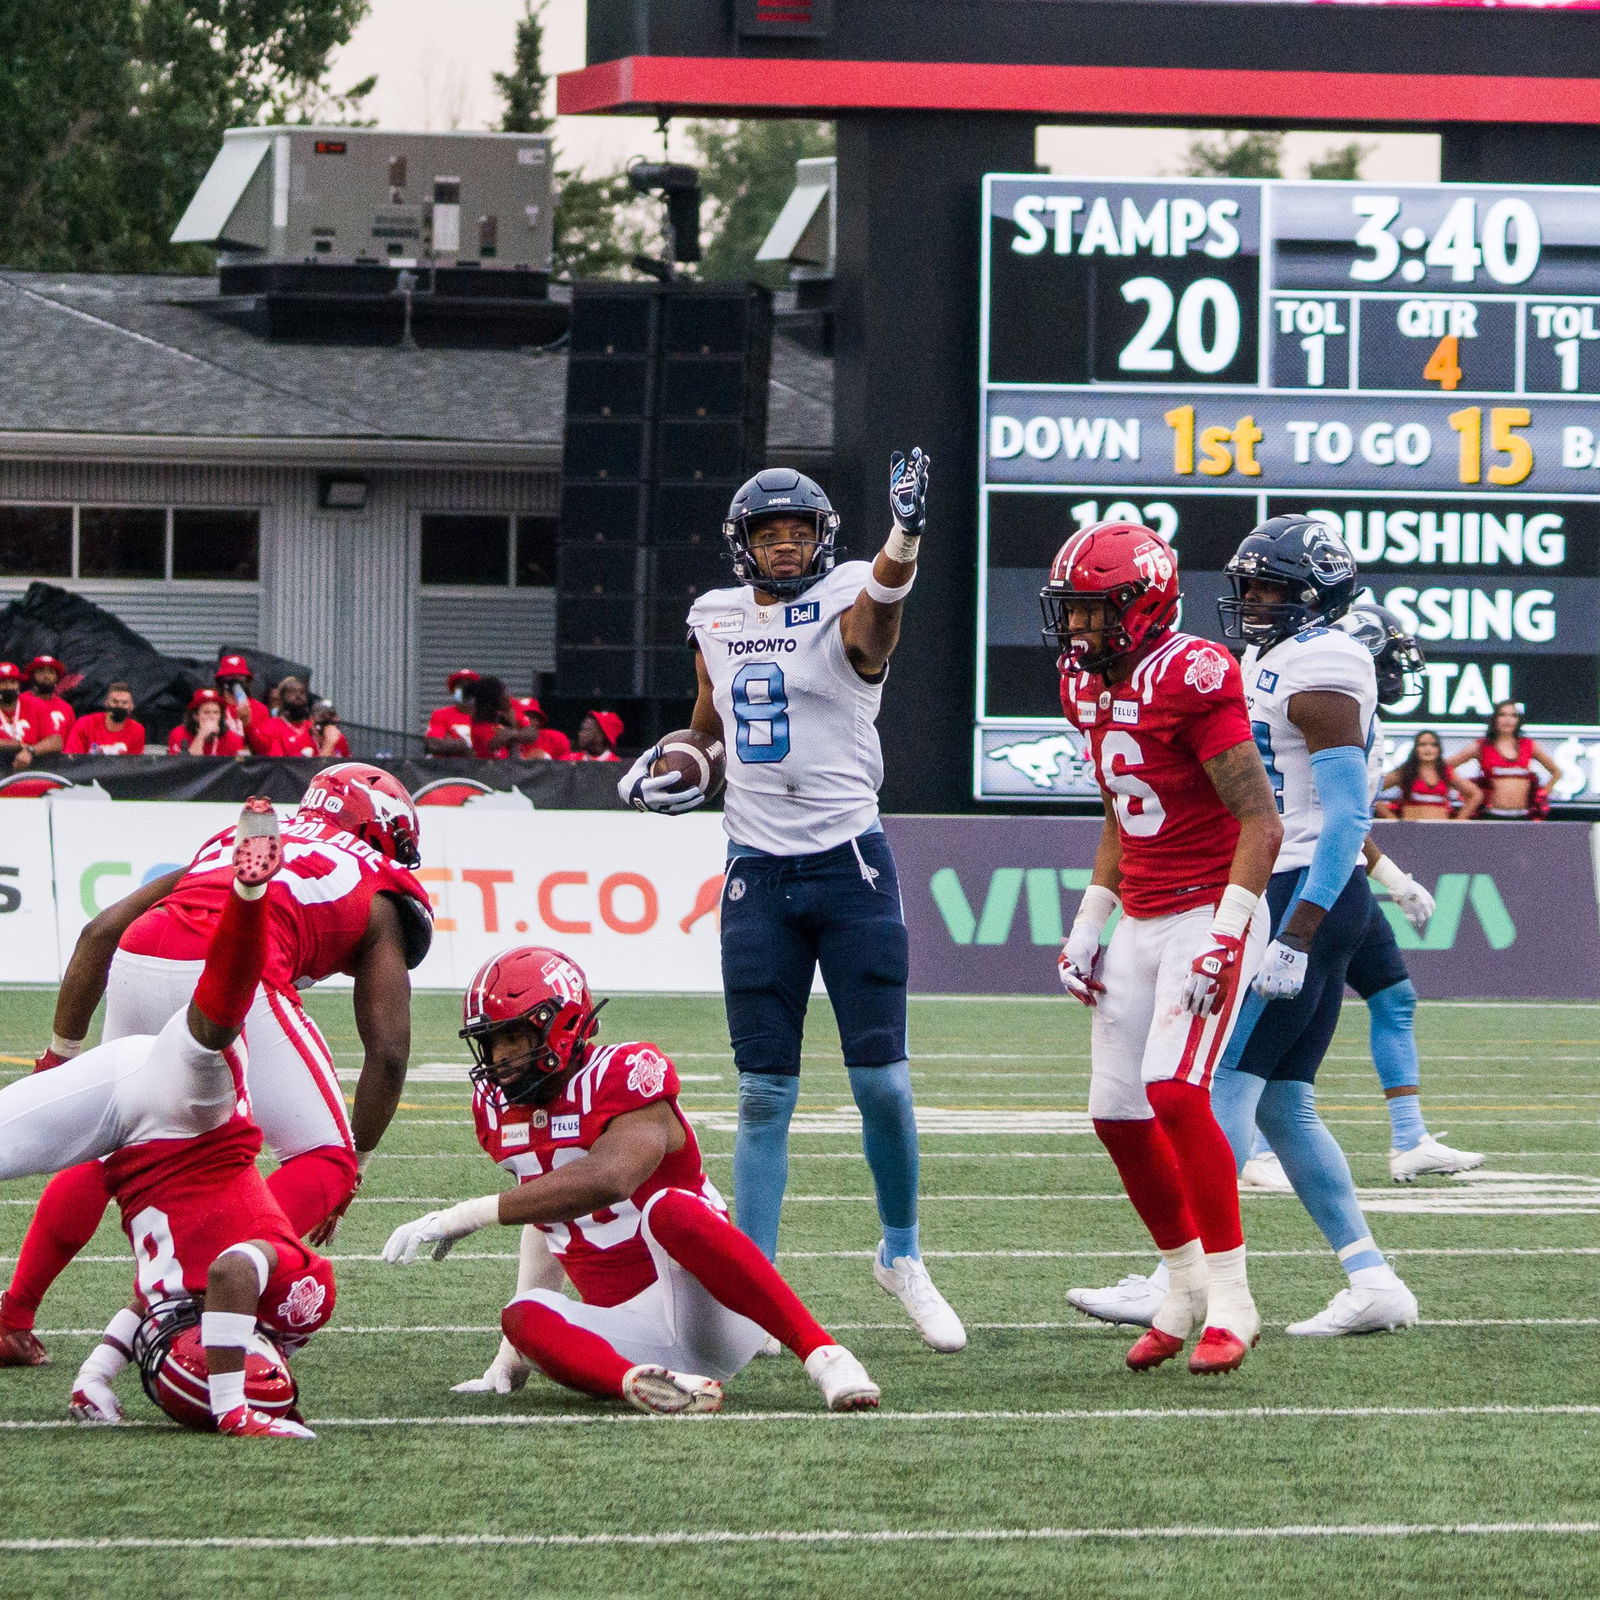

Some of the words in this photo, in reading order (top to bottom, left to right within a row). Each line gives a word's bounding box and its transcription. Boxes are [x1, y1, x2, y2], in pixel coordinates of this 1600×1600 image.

[1011, 195, 1240, 258] STAMPS
[1349, 197, 1541, 284] 3:40
[1118, 276, 1242, 374] 20
[1275, 300, 1345, 335] TOL
[1397, 300, 1478, 338] QTR
[1531, 305, 1600, 340] TOL
[1300, 335, 1326, 387] 1
[1422, 335, 1462, 391] 4
[1554, 338, 1580, 391] 1
[989, 416, 1140, 460] DOWN
[1164, 405, 1263, 476] 1st
[1287, 422, 1353, 464] TO
[1360, 422, 1431, 466] GO
[1448, 406, 1533, 485] 15
[1562, 425, 1600, 469] B
[768, 498, 791, 506] ARGOS
[790, 604, 815, 624] Bell
[1355, 587, 1557, 642] SSING
[727, 639, 797, 656] TORONTO
[731, 662, 791, 764] 8
[1113, 706, 1137, 717] TELUS
[1380, 662, 1525, 716] TAL
[543, 960, 584, 1005] 75
[552, 1121, 579, 1131] TELUS
